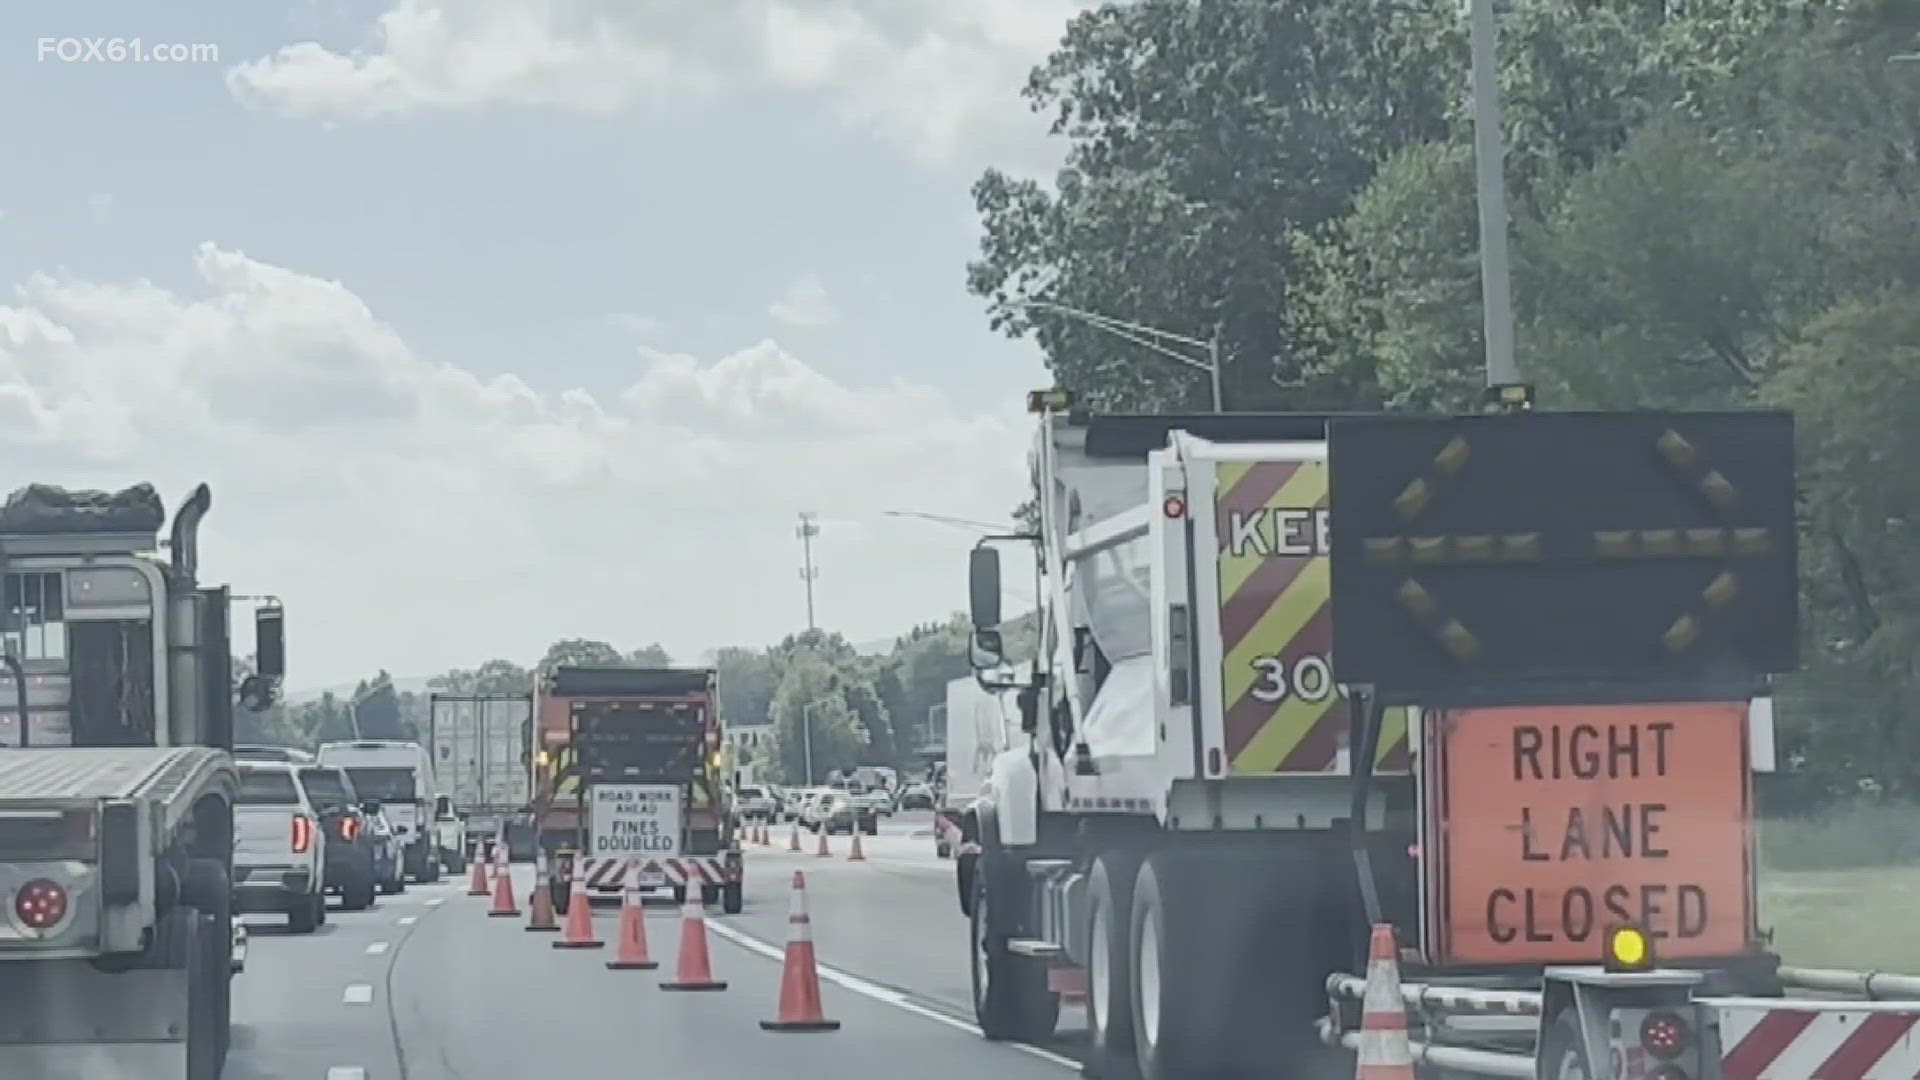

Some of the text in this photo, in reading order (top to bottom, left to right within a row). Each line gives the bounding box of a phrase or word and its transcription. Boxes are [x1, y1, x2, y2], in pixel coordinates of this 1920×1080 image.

[1251, 655, 1350, 701] 30
[1512, 722, 1674, 781] RIGHT
[612, 820, 659, 835] FINES
[616, 803, 657, 814] AHEAD
[598, 836, 673, 851] DOUBLED
[1521, 803, 1669, 861] LANE
[1486, 884, 1708, 943] CLOSED
